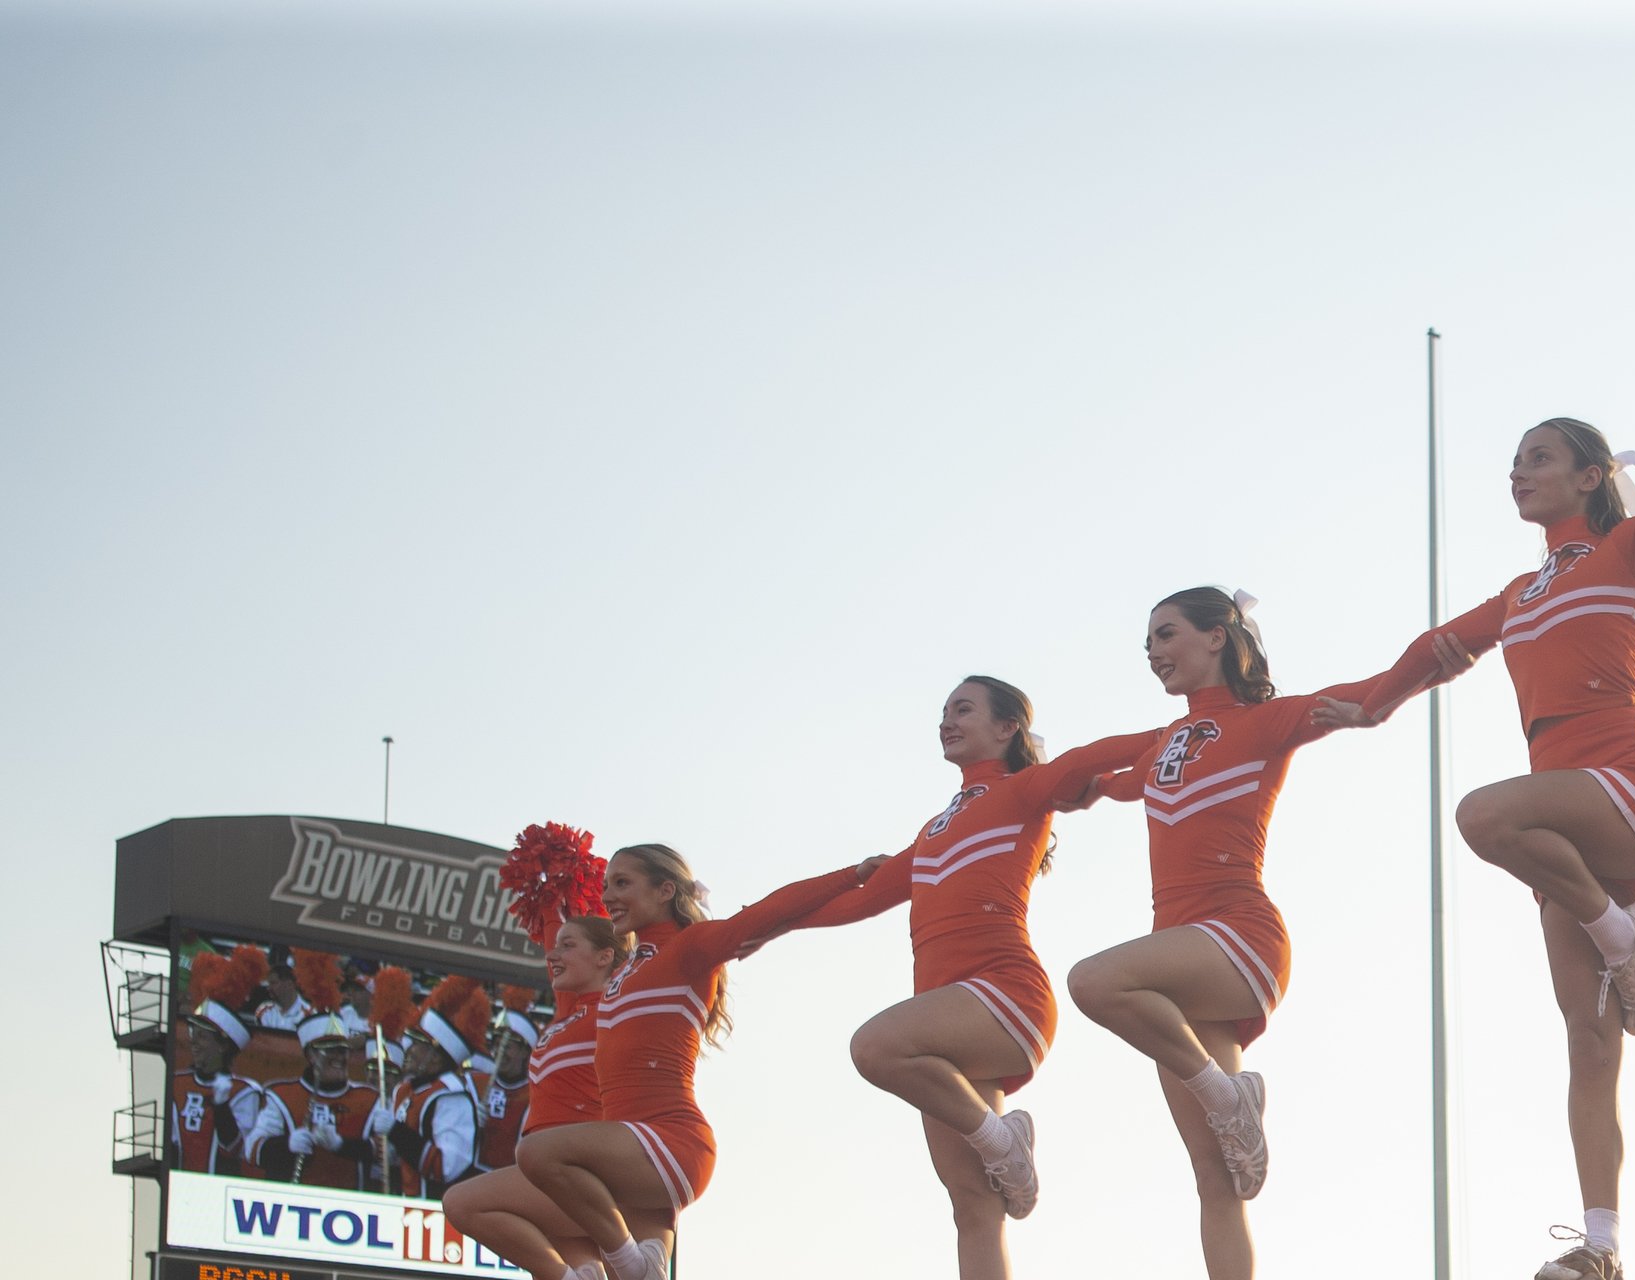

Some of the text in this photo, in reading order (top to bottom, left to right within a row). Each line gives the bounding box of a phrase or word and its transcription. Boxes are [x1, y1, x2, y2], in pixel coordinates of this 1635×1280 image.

[291, 830, 469, 922] BOWLING
[340, 905, 536, 956] FOOTBALL
[232, 1198, 394, 1250] WTOL
